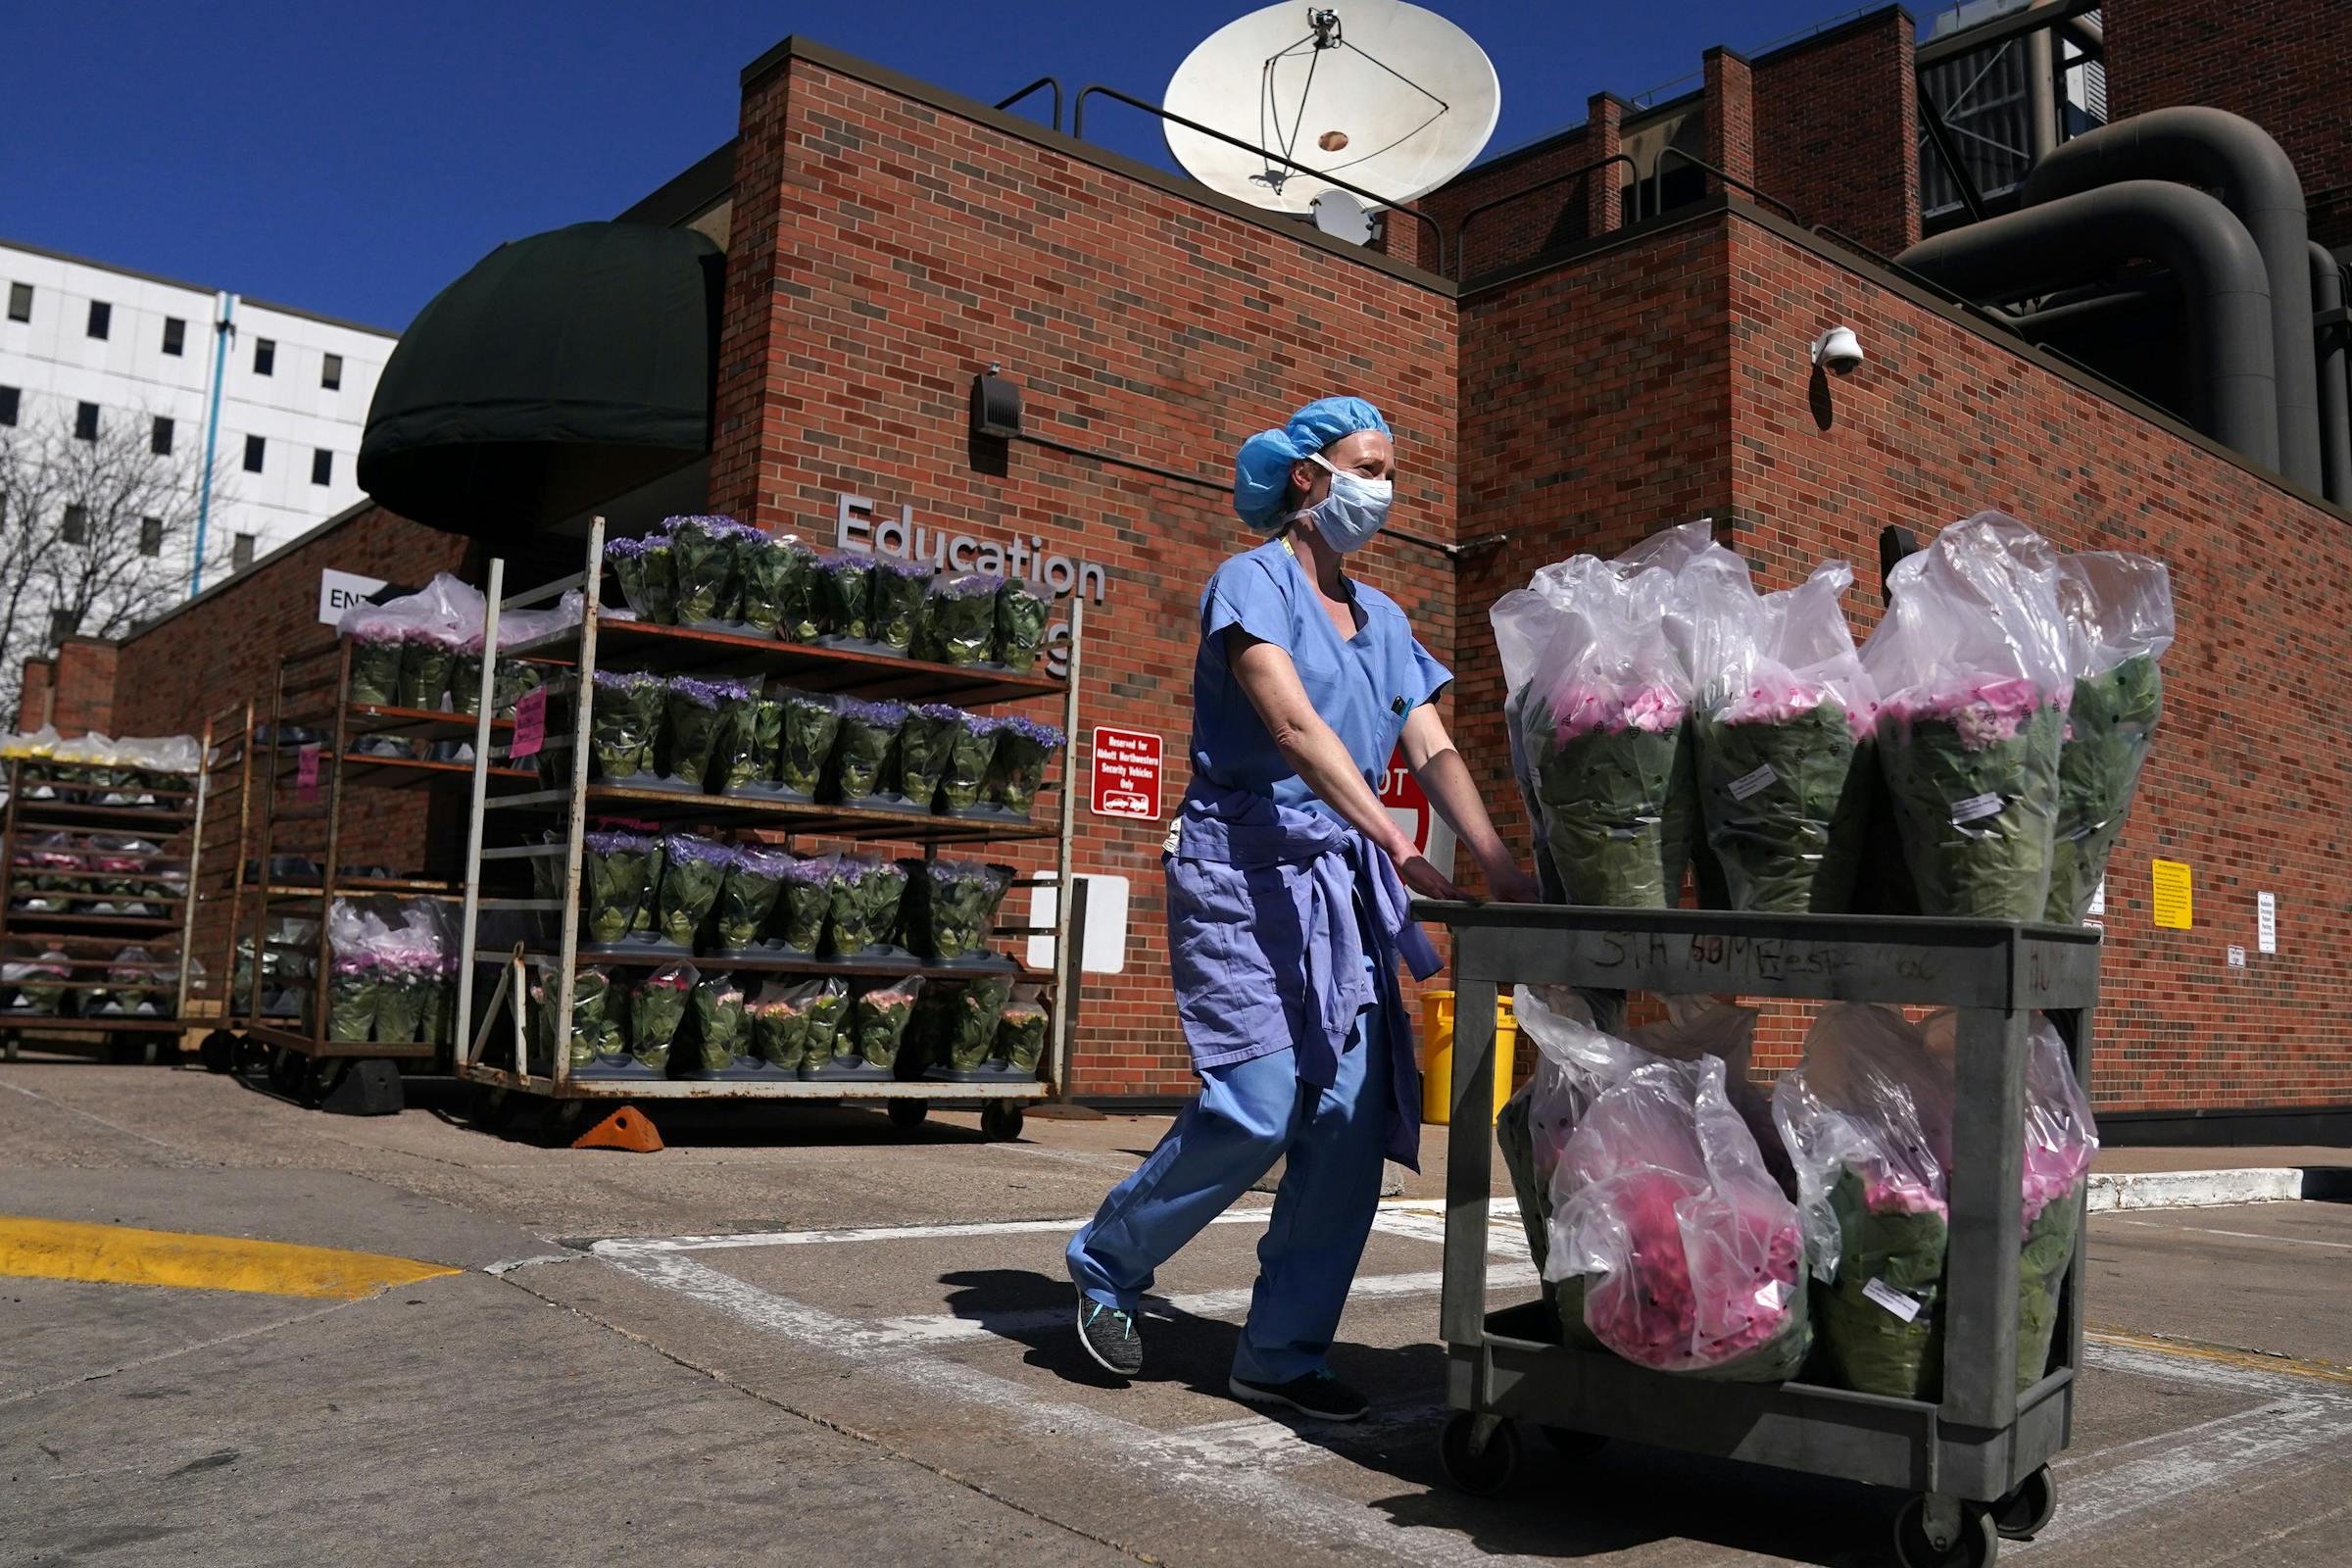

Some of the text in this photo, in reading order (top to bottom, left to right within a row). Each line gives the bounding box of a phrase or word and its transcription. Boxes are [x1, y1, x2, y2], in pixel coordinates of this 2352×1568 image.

[837, 493, 1105, 603] Education
[1108, 736, 1149, 751] Reserved for
[1097, 748, 1158, 765] Abbott Northwestern
[1101, 761, 1153, 779] Security Vehicles
[1120, 778, 1134, 791] Only
